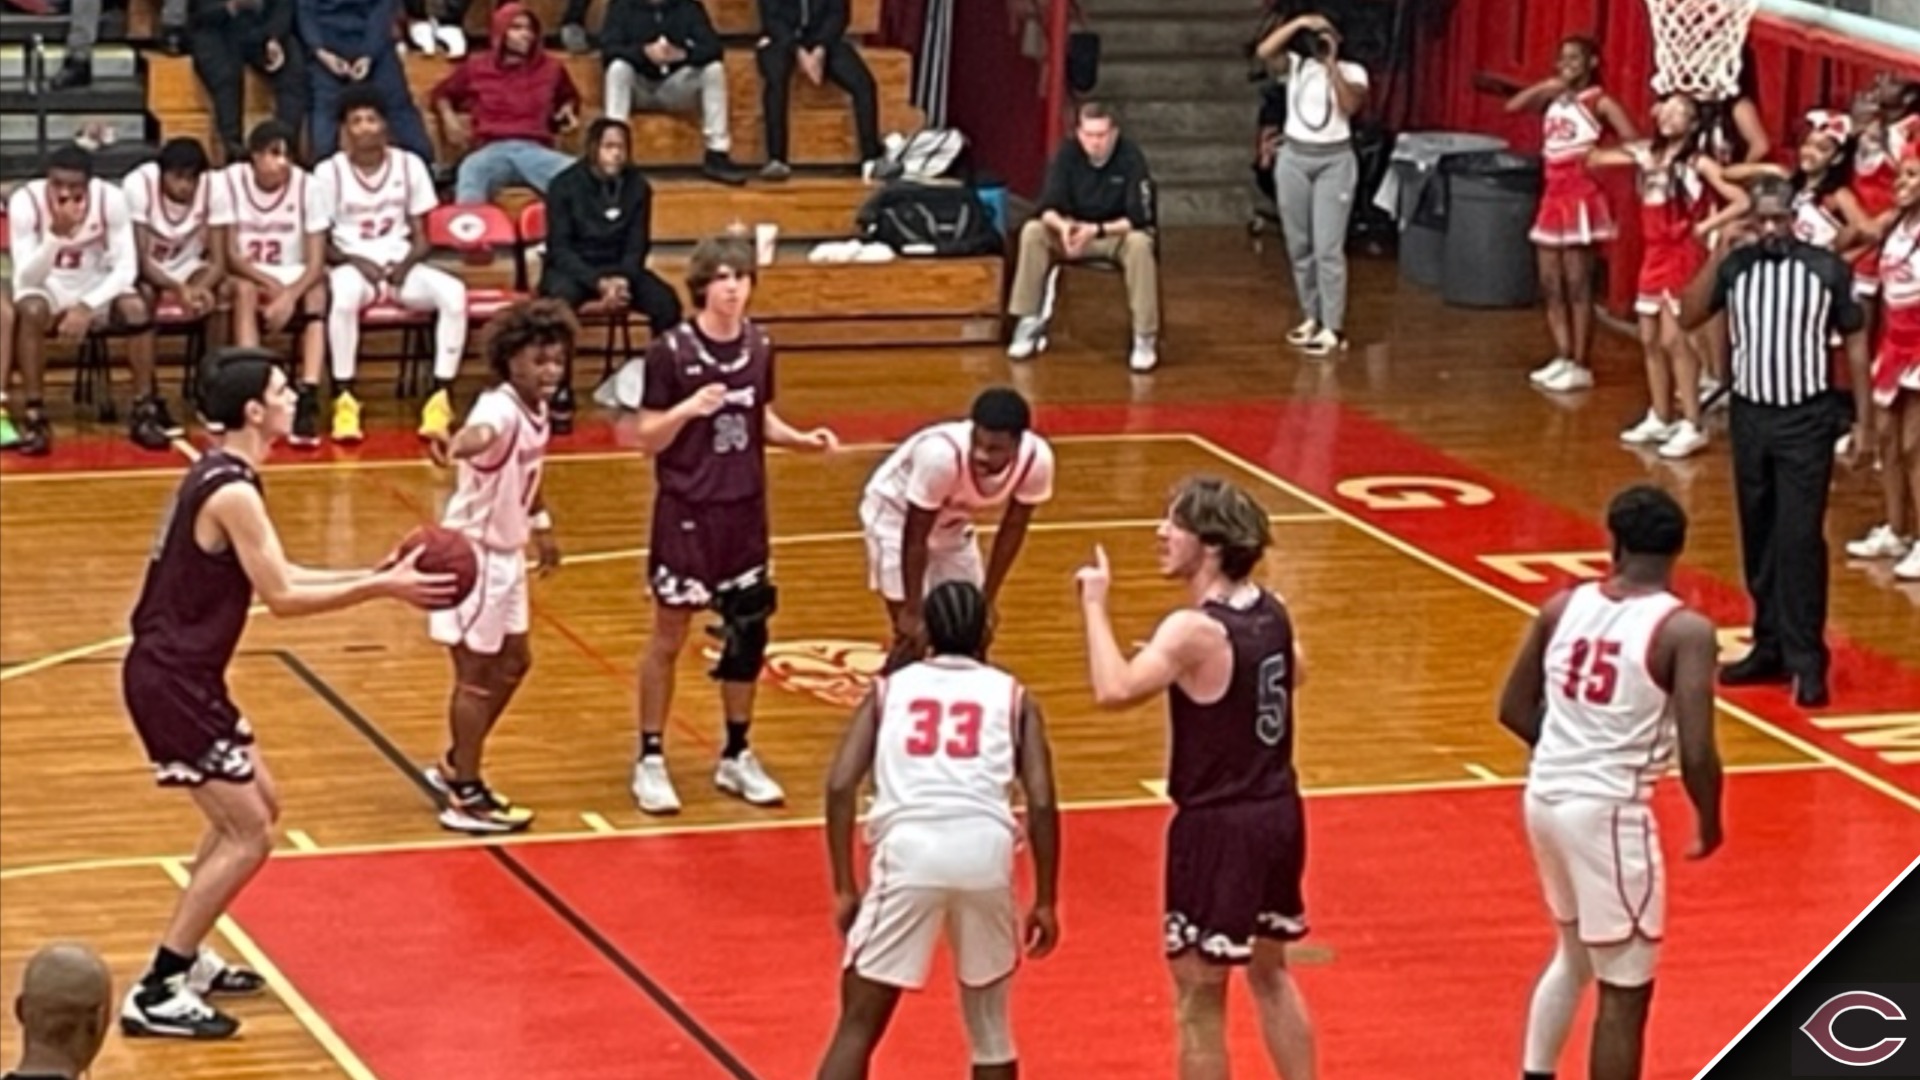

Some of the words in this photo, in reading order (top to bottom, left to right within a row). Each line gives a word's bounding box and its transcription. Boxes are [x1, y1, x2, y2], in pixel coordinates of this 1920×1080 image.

[1255, 654, 1287, 746] 5
[1562, 637, 1622, 706] 15
[905, 698, 984, 759] 33
